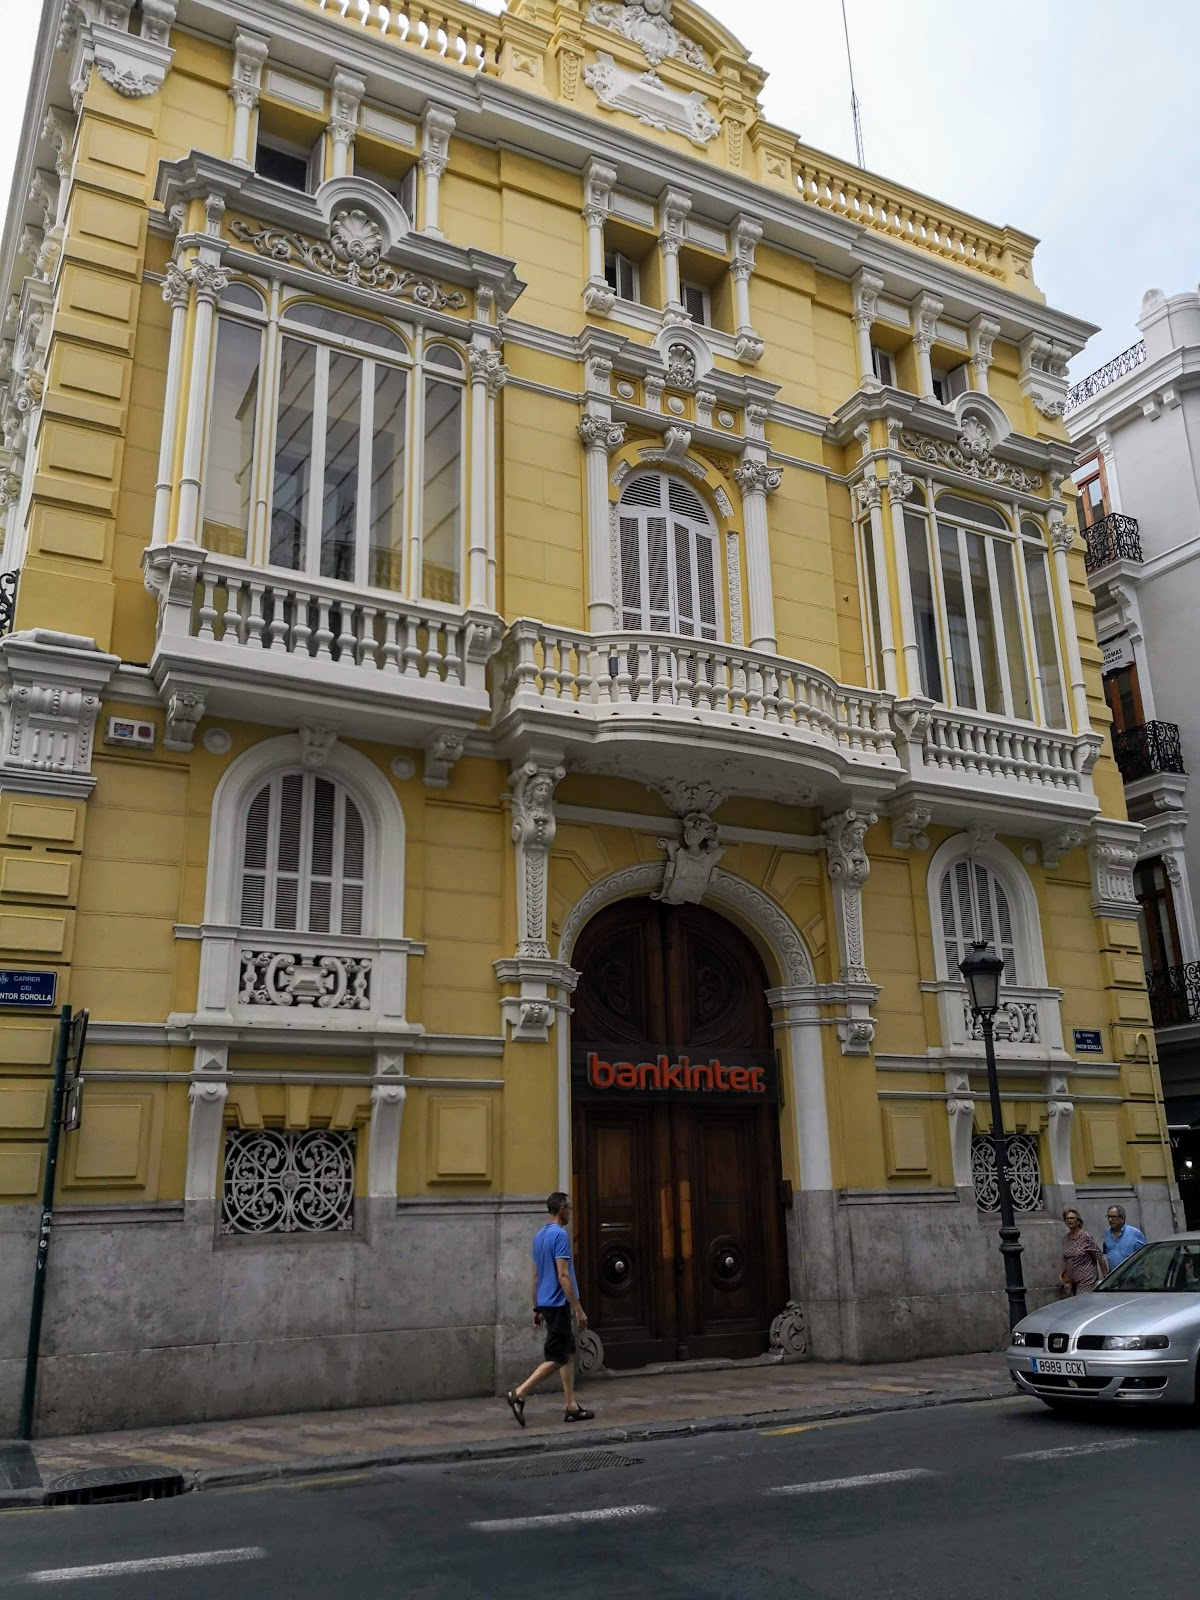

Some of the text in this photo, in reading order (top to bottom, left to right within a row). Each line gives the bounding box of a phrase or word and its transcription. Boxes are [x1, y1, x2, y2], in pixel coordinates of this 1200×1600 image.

[13, 975, 41, 983] CARRER
[20, 993, 52, 1001] SOROLLA
[1039, 1360, 1084, 1375] 8989 CCK
